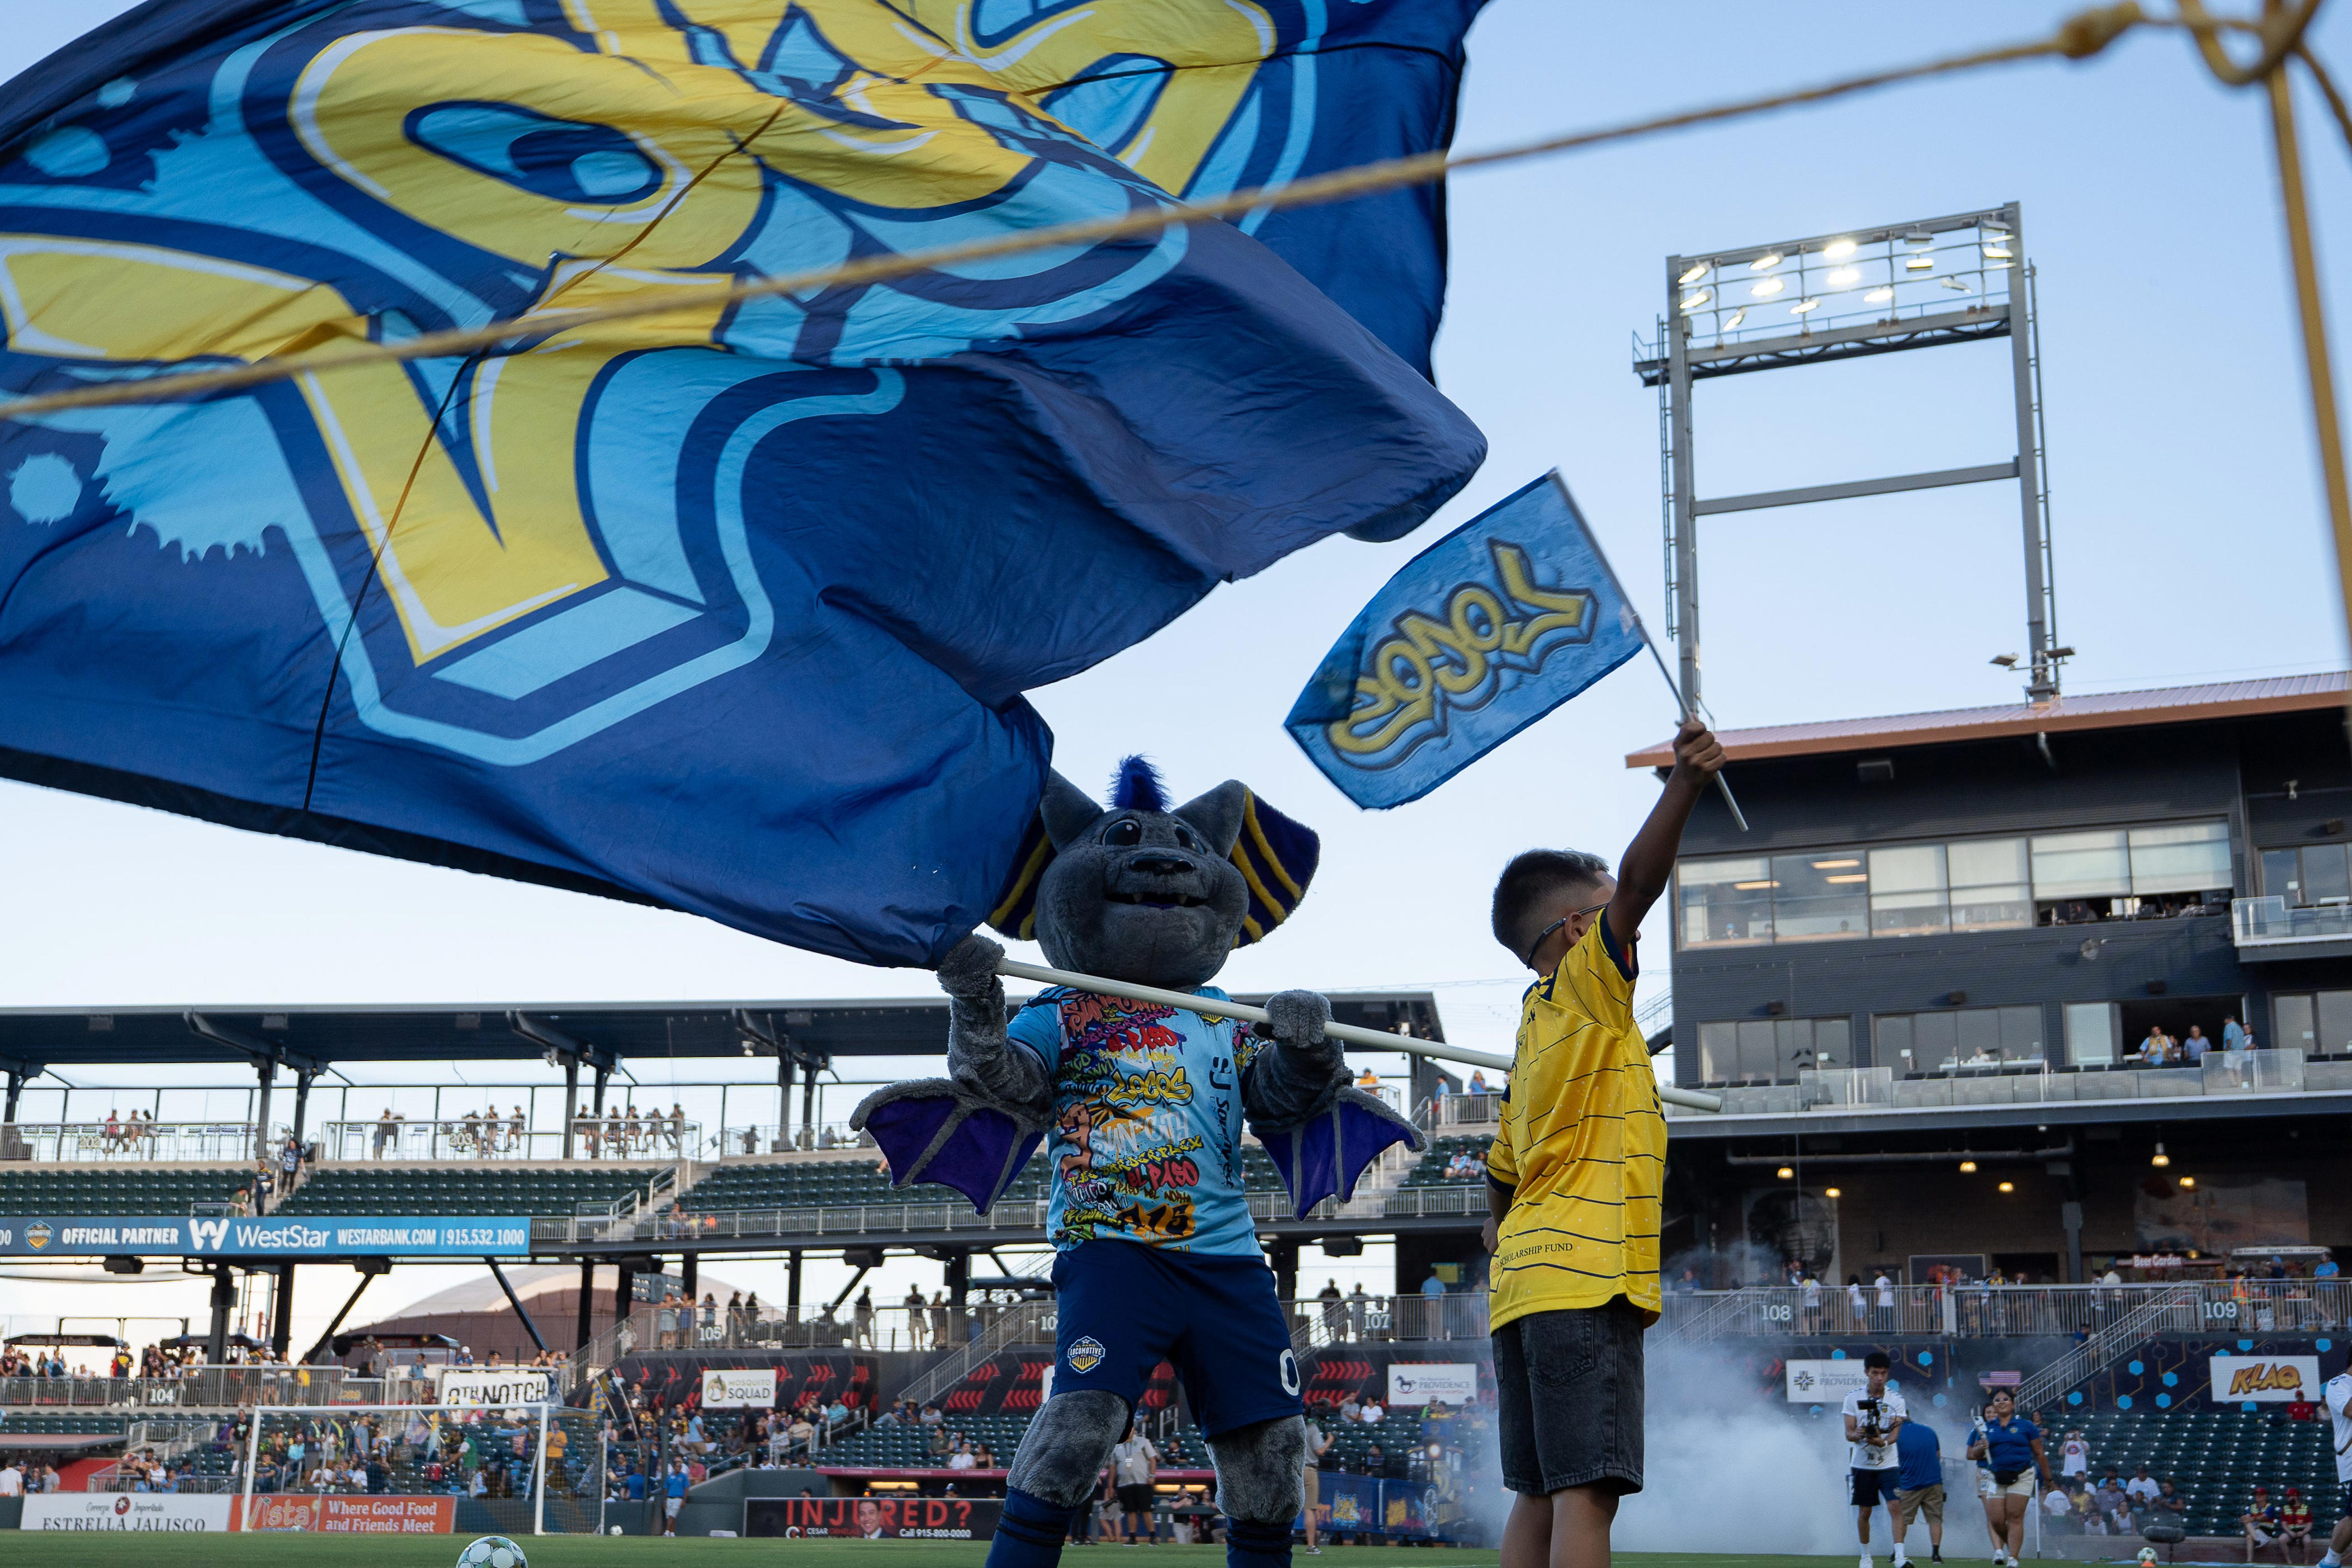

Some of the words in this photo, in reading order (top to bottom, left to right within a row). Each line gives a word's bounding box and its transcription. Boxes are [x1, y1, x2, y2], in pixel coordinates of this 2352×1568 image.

[1104, 1066, 1193, 1109] LOCOS
[79, 1136, 101, 1148] 202
[1090, 1119, 1139, 1152] SUN
[1146, 1159, 1200, 1191] PASO
[62, 1228, 119, 1245] OFFICIAL
[121, 1228, 179, 1244] PARTNER
[236, 1225, 331, 1248] WestStar
[337, 1229, 436, 1245] WESTARBANK.COM
[447, 1229, 525, 1245] 915.532.1000
[1499, 1245, 1542, 1267] SCHOLARSHIP
[1545, 1243, 1573, 1253] FUND
[2133, 1254, 2152, 1268] Beer
[2153, 1254, 2182, 1267] Garden
[1761, 1305, 1791, 1321] 108
[2204, 1302, 2237, 1319] 109
[1041, 1315, 1058, 1330] 10
[1364, 1314, 1390, 1329] 107
[699, 1326, 722, 1342] 105
[1070, 1347, 1102, 1356] LOCOMOTIVE
[1820, 1377, 1869, 1386] PROVIDEN
[2229, 1362, 2303, 1395] KLAQ
[149, 1388, 174, 1403] 104
[483, 1380, 546, 1403] NOTCH
[728, 1388, 771, 1399] SQUAD
[328, 1500, 370, 1515] Where
[372, 1501, 404, 1515] Good
[407, 1502, 437, 1515] Food
[42, 1517, 127, 1531] ESTRELLA
[133, 1517, 206, 1532] JALISCO
[325, 1519, 350, 1531] and
[352, 1518, 399, 1532] Friends
[402, 1519, 435, 1532] Meet
[899, 1528, 915, 1538] Call
